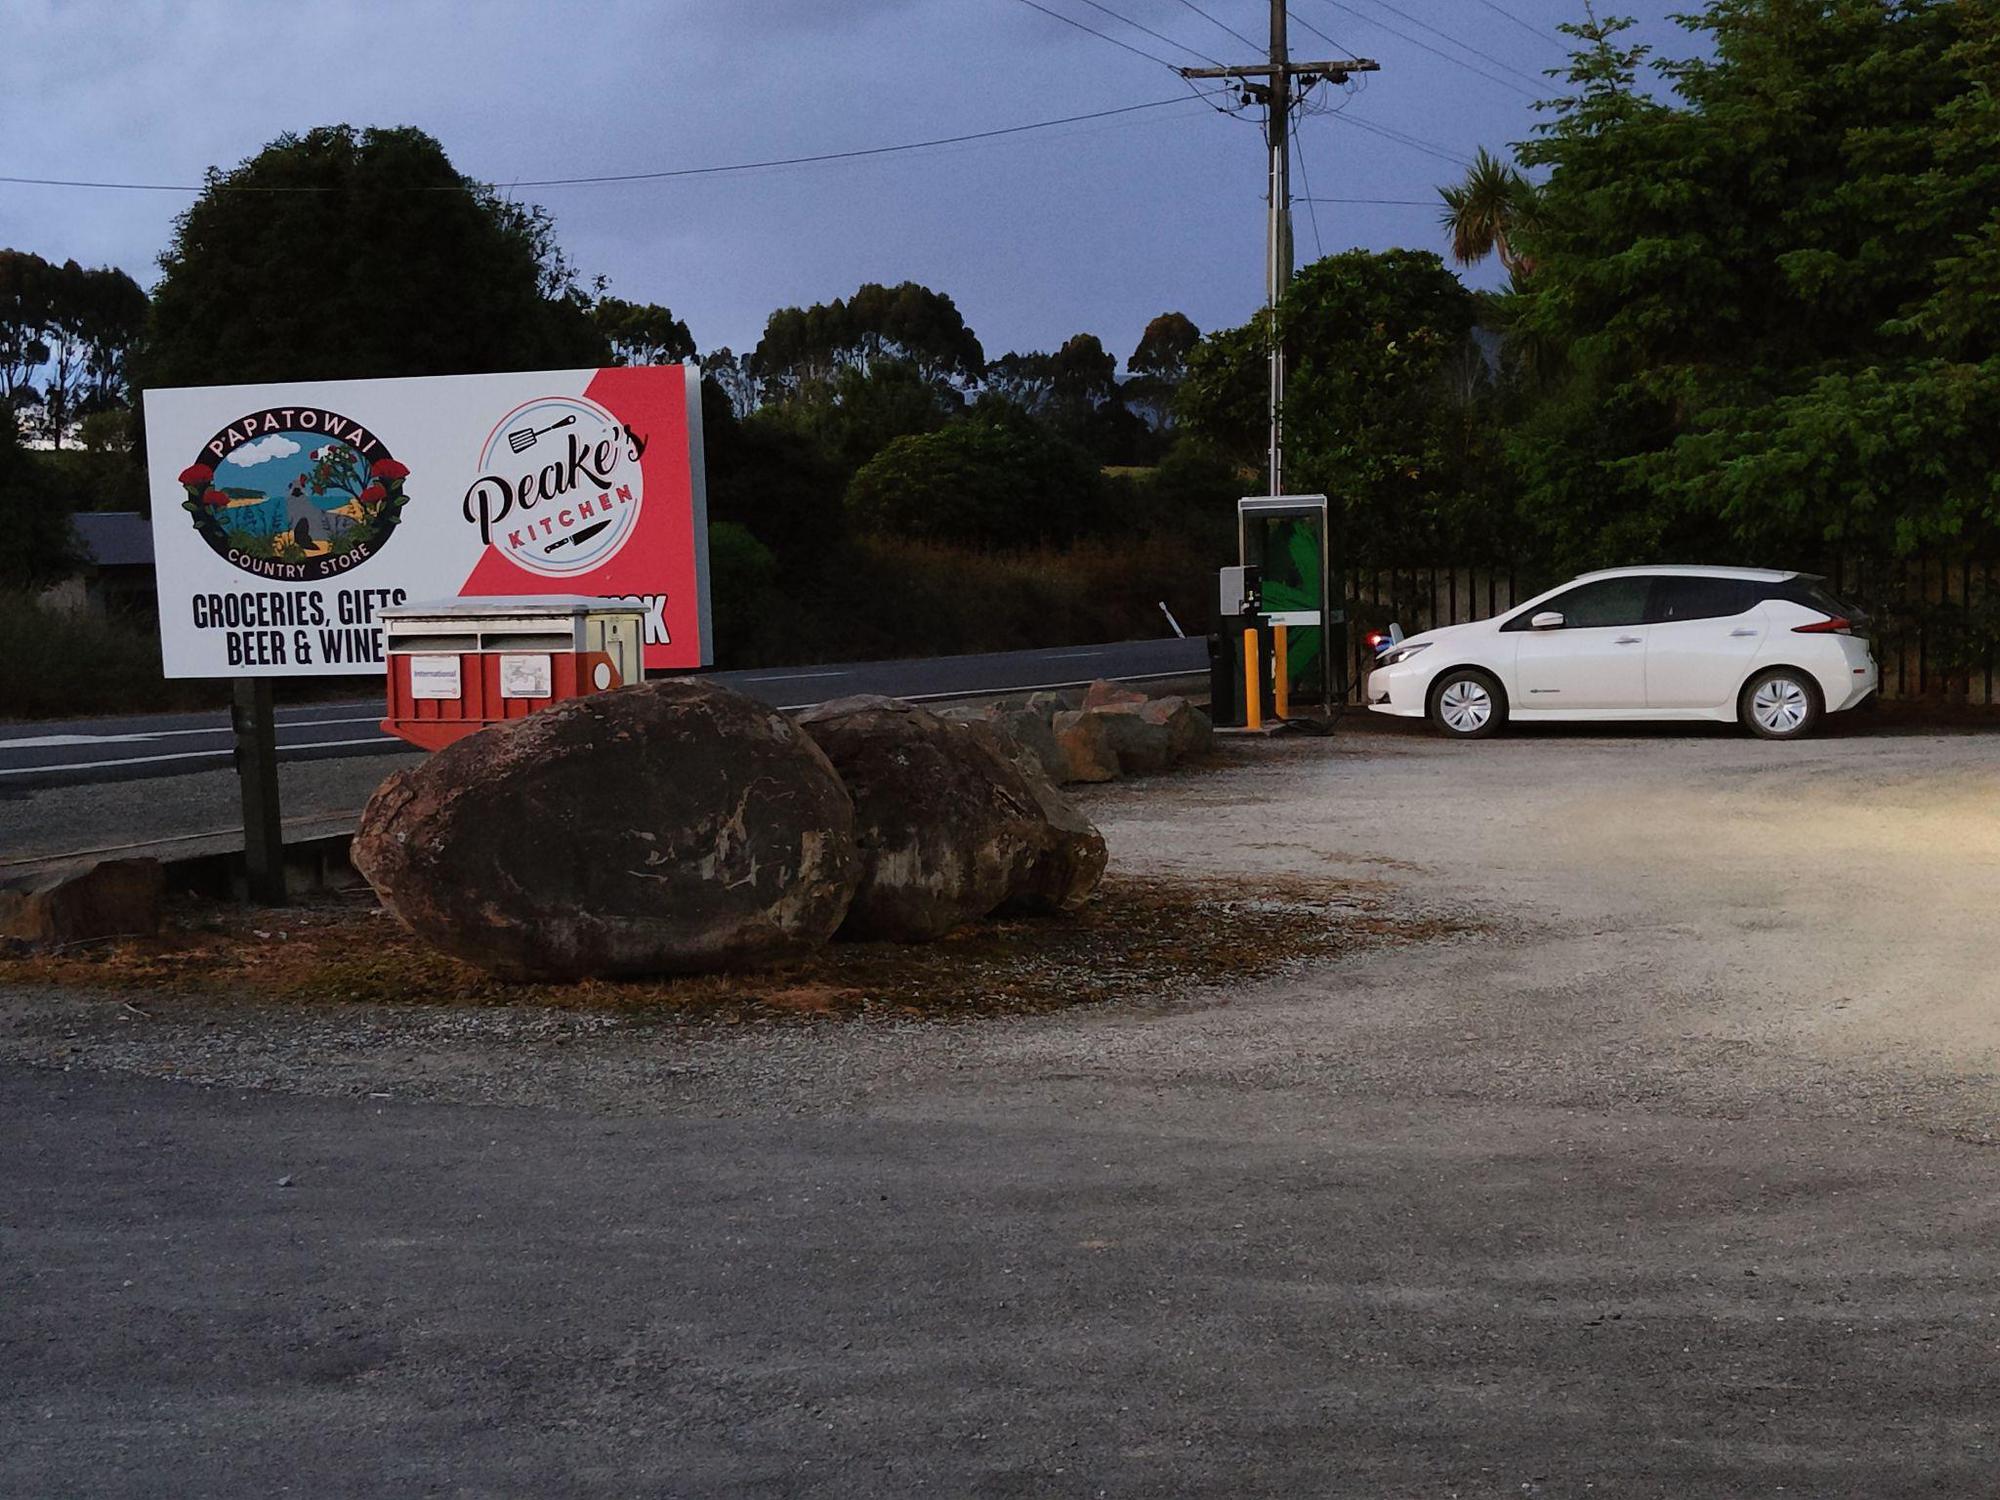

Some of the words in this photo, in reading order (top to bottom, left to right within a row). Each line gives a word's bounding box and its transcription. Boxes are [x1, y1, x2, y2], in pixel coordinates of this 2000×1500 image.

[209, 411, 376, 457] PAPATOWAI
[463, 424, 648, 545] Peake's
[508, 484, 633, 549] KITCHEN
[228, 549, 305, 577] COUNTRY
[320, 543, 370, 574] STORE
[192, 591, 330, 628] GROCERIES,
[226, 630, 287, 666] BEER
[293, 630, 313, 665] &
[318, 628, 386, 664] WINE
